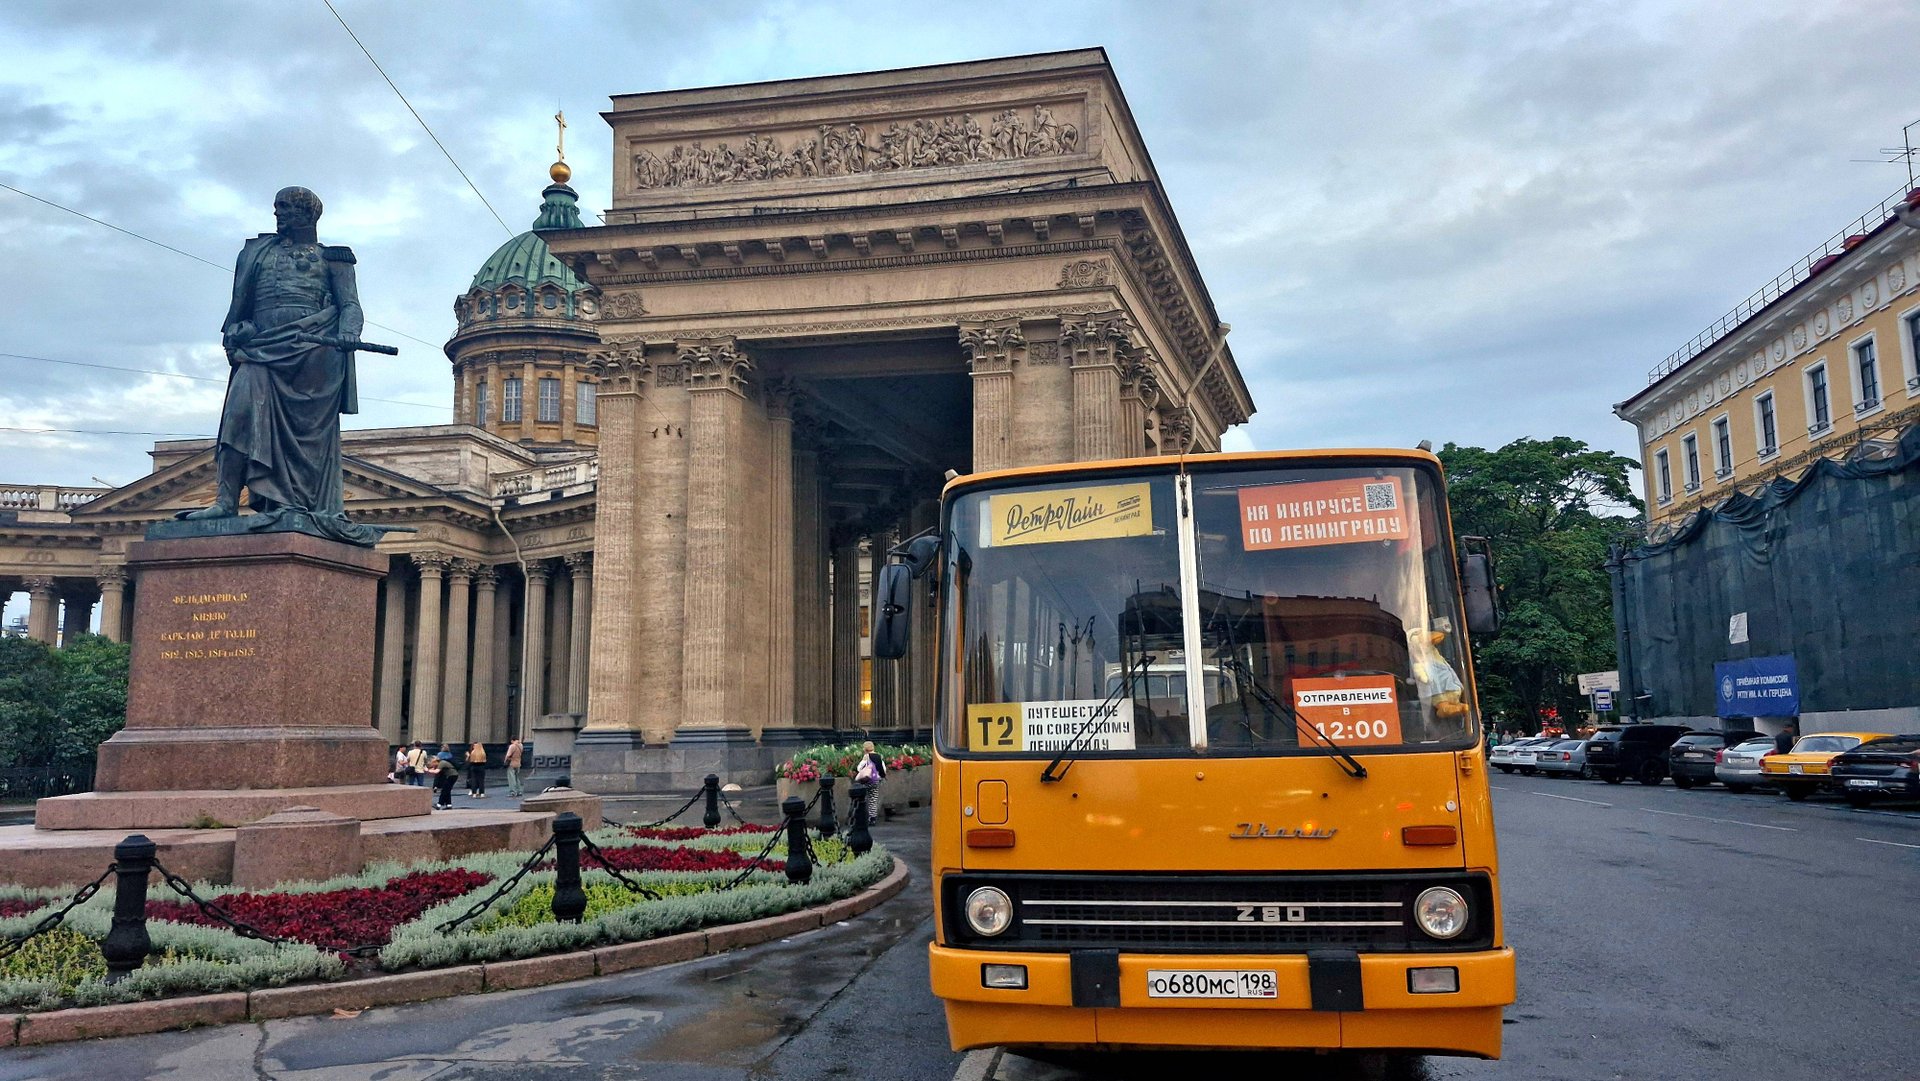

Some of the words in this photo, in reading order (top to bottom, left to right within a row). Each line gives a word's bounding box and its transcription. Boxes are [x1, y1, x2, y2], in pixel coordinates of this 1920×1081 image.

[1247, 505, 1269, 521] НА
[1276, 497, 1363, 519] ИКАРУСЕ
[1249, 527, 1272, 544] ПО
[1280, 517, 1401, 542] ЛЕНИНГРАДУ
[1303, 692, 1387, 703] ОТПРАВЛЕНИЕ
[1028, 705, 1118, 719] ПУТЕШЕСТВИЕ
[1343, 707, 1350, 716] В
[978, 716, 1014, 746] Т2
[1028, 724, 1043, 735] ПО
[1047, 722, 1130, 735] СОВЕТСКОМУ
[1315, 720, 1388, 740] 12:00
[1240, 974, 1271, 989] 198
